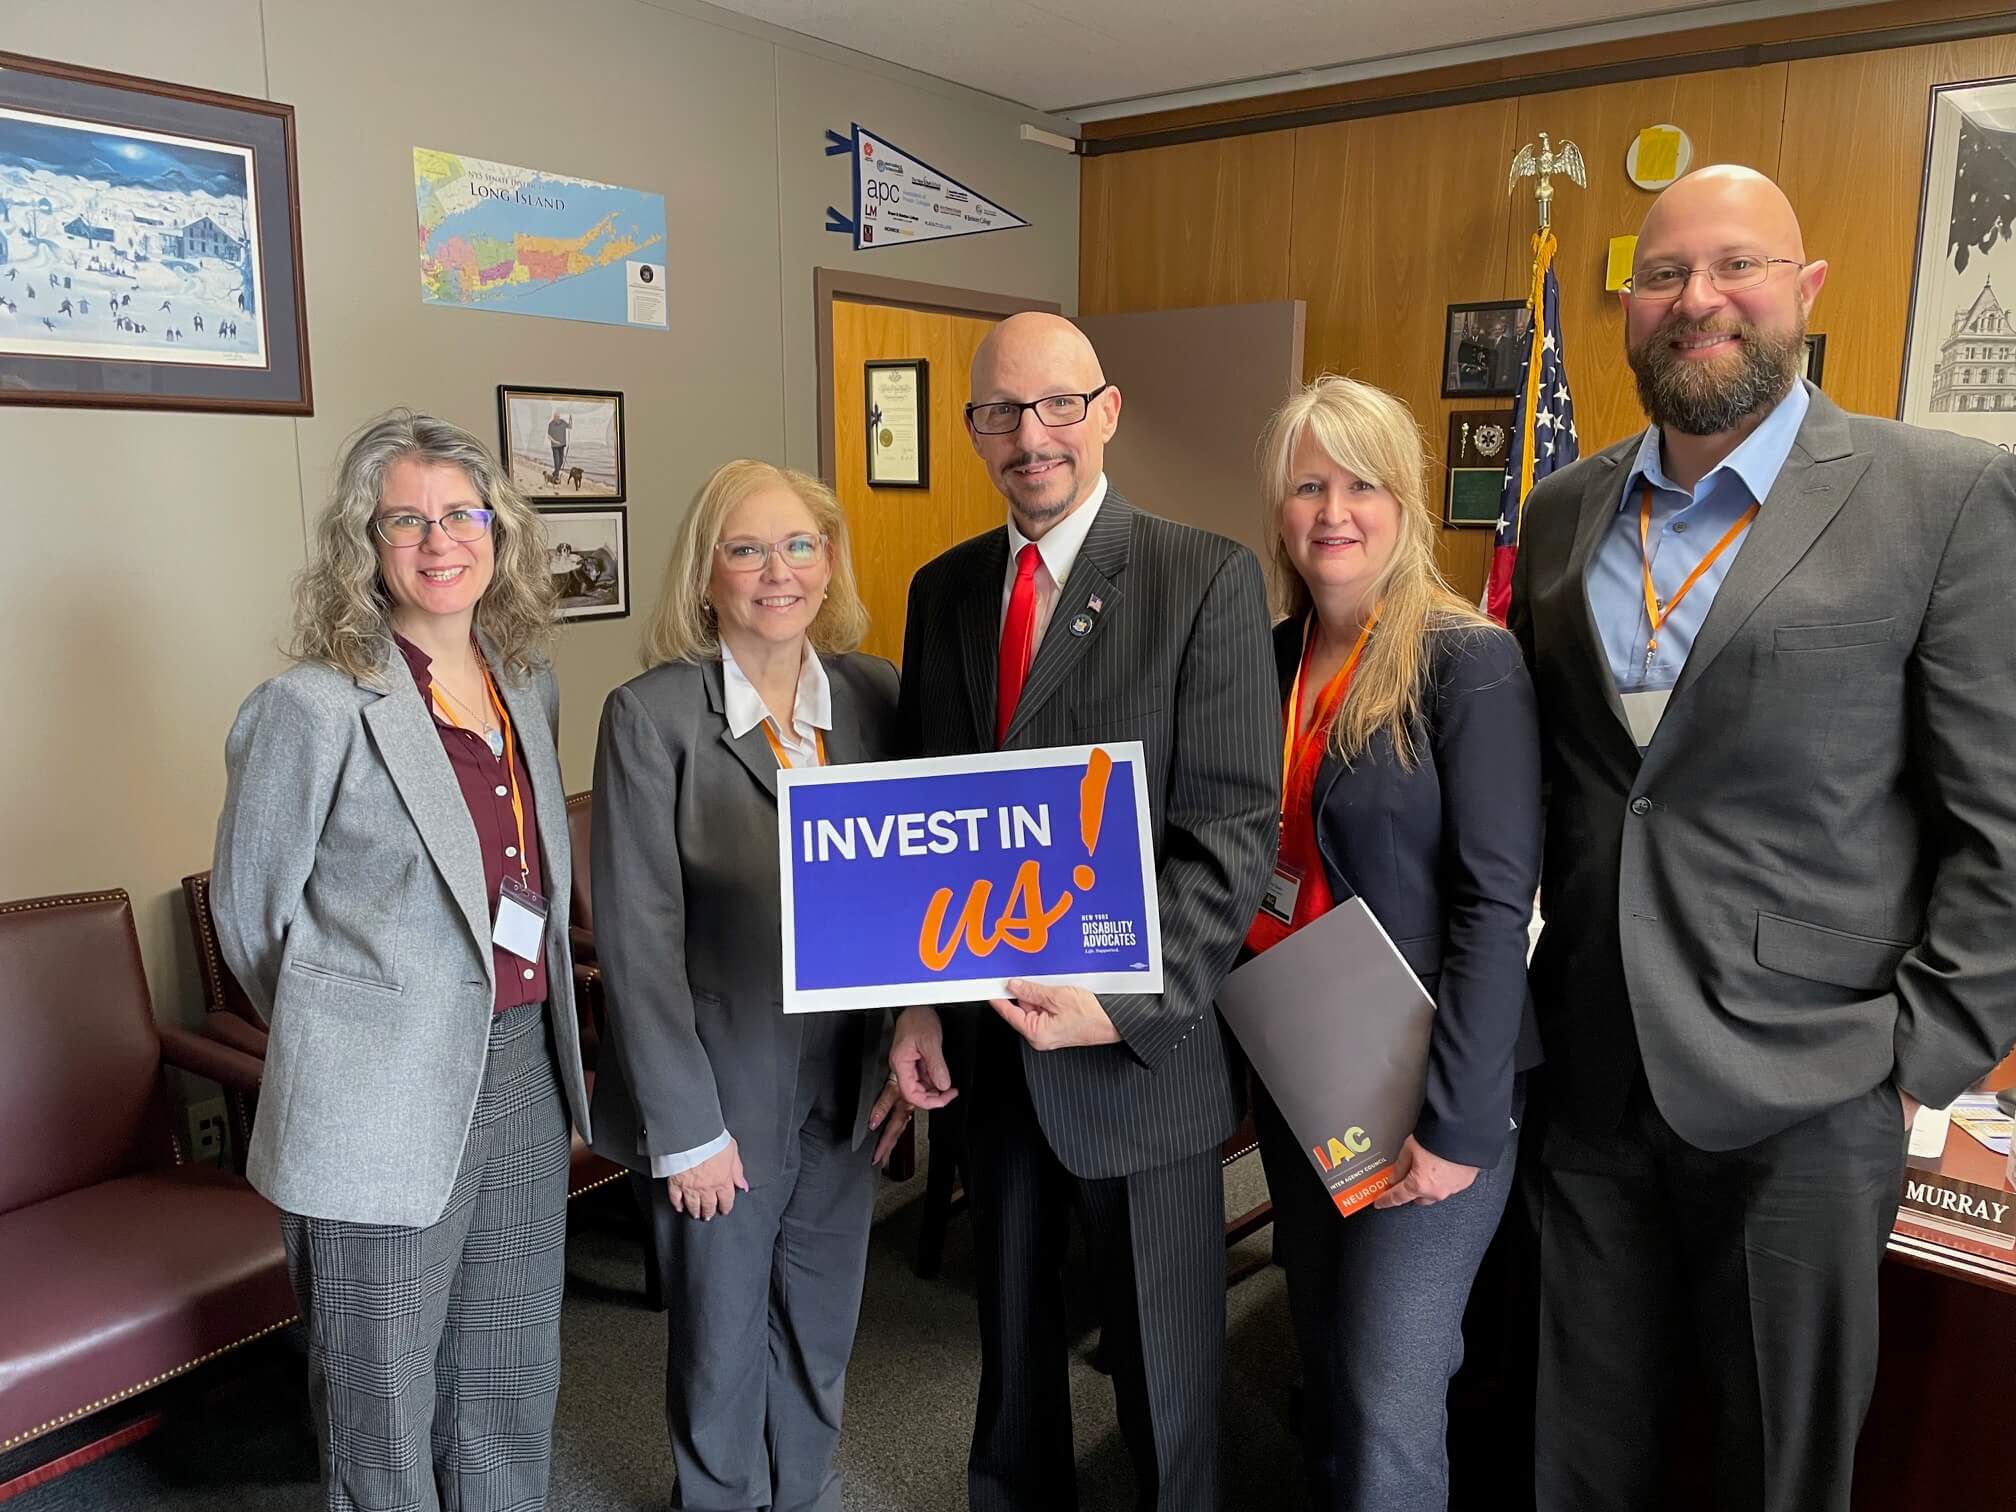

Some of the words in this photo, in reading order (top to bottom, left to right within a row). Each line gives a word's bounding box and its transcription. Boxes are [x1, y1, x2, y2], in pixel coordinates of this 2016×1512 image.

[470, 182, 511, 202] LONG
[515, 190, 566, 211] ISLAND
[867, 179, 900, 206] apc
[865, 203, 877, 217] LM
[803, 807, 989, 863] INVEST
[998, 803, 1051, 849] IN
[1082, 920, 1133, 935] DISABILITY
[1083, 933, 1137, 948] ADVOCATES
[1313, 1126, 1372, 1174] IAC
[1344, 1169, 1364, 1184] AGENCY
[1364, 1157, 1388, 1172] COUNCIL
[1905, 1180, 2010, 1224] MURRAY
